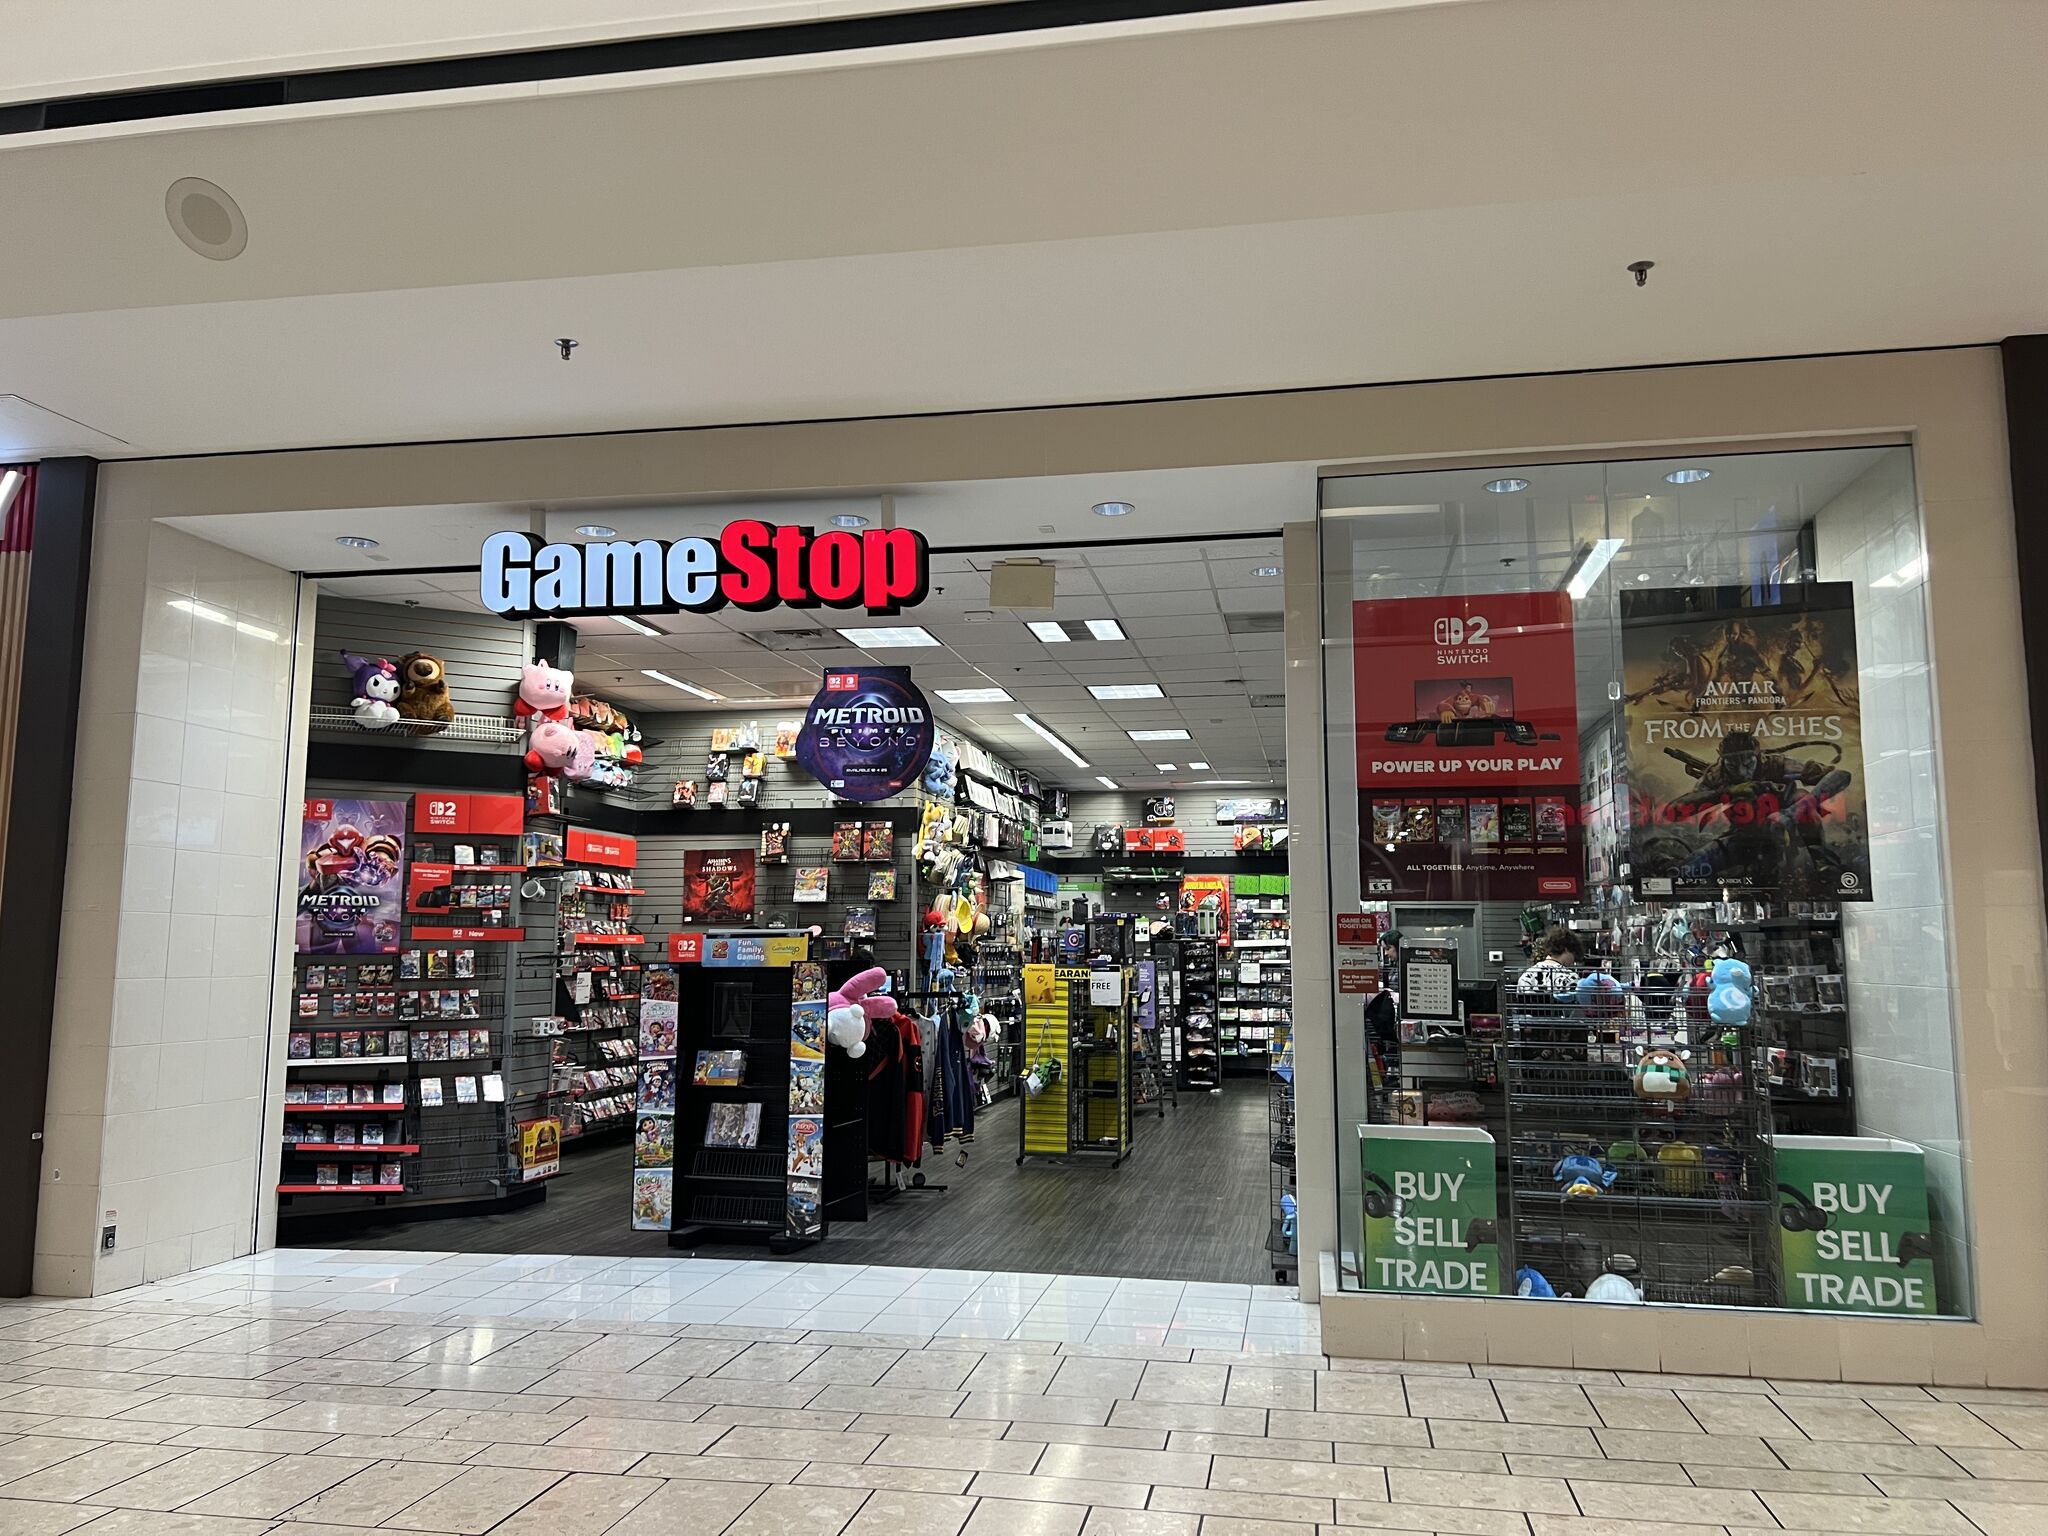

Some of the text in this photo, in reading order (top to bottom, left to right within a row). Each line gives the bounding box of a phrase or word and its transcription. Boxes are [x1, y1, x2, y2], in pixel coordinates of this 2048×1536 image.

[480, 518, 918, 614] GameStop
[1466, 615, 1490, 645] 2
[1437, 648, 1489, 656] NINTENDO
[1437, 654, 1489, 665] SWITCH
[1703, 680, 1778, 696] AVATAR
[1696, 695, 1787, 707] FRONTIERS PANDORA
[812, 707, 925, 725] METROID
[1644, 715, 1843, 744] FROM THE ASHES
[819, 736, 917, 747] BEYOND
[1371, 757, 1563, 774] POWER UP YOUR PLAY
[445, 801, 457, 816] 2
[702, 865, 737, 873] SHADOWS
[1422, 864, 1464, 872] TOGETHER,
[1466, 864, 1498, 872] Anytime,
[1499, 864, 1535, 872] Anywhere
[301, 894, 380, 906] METROID
[688, 941, 696, 951] 2
[736, 953, 767, 961] Gaming.
[1055, 969, 1092, 978] EARAN
[1091, 982, 1111, 990] FREE
[1394, 1171, 1466, 1202] BUY
[1812, 1182, 1893, 1215] BUY
[1394, 1216, 1468, 1248] SELL
[1815, 1229, 1901, 1263] SELL
[1375, 1257, 1488, 1291] TRADE
[1796, 1272, 1926, 1309] TRADE
